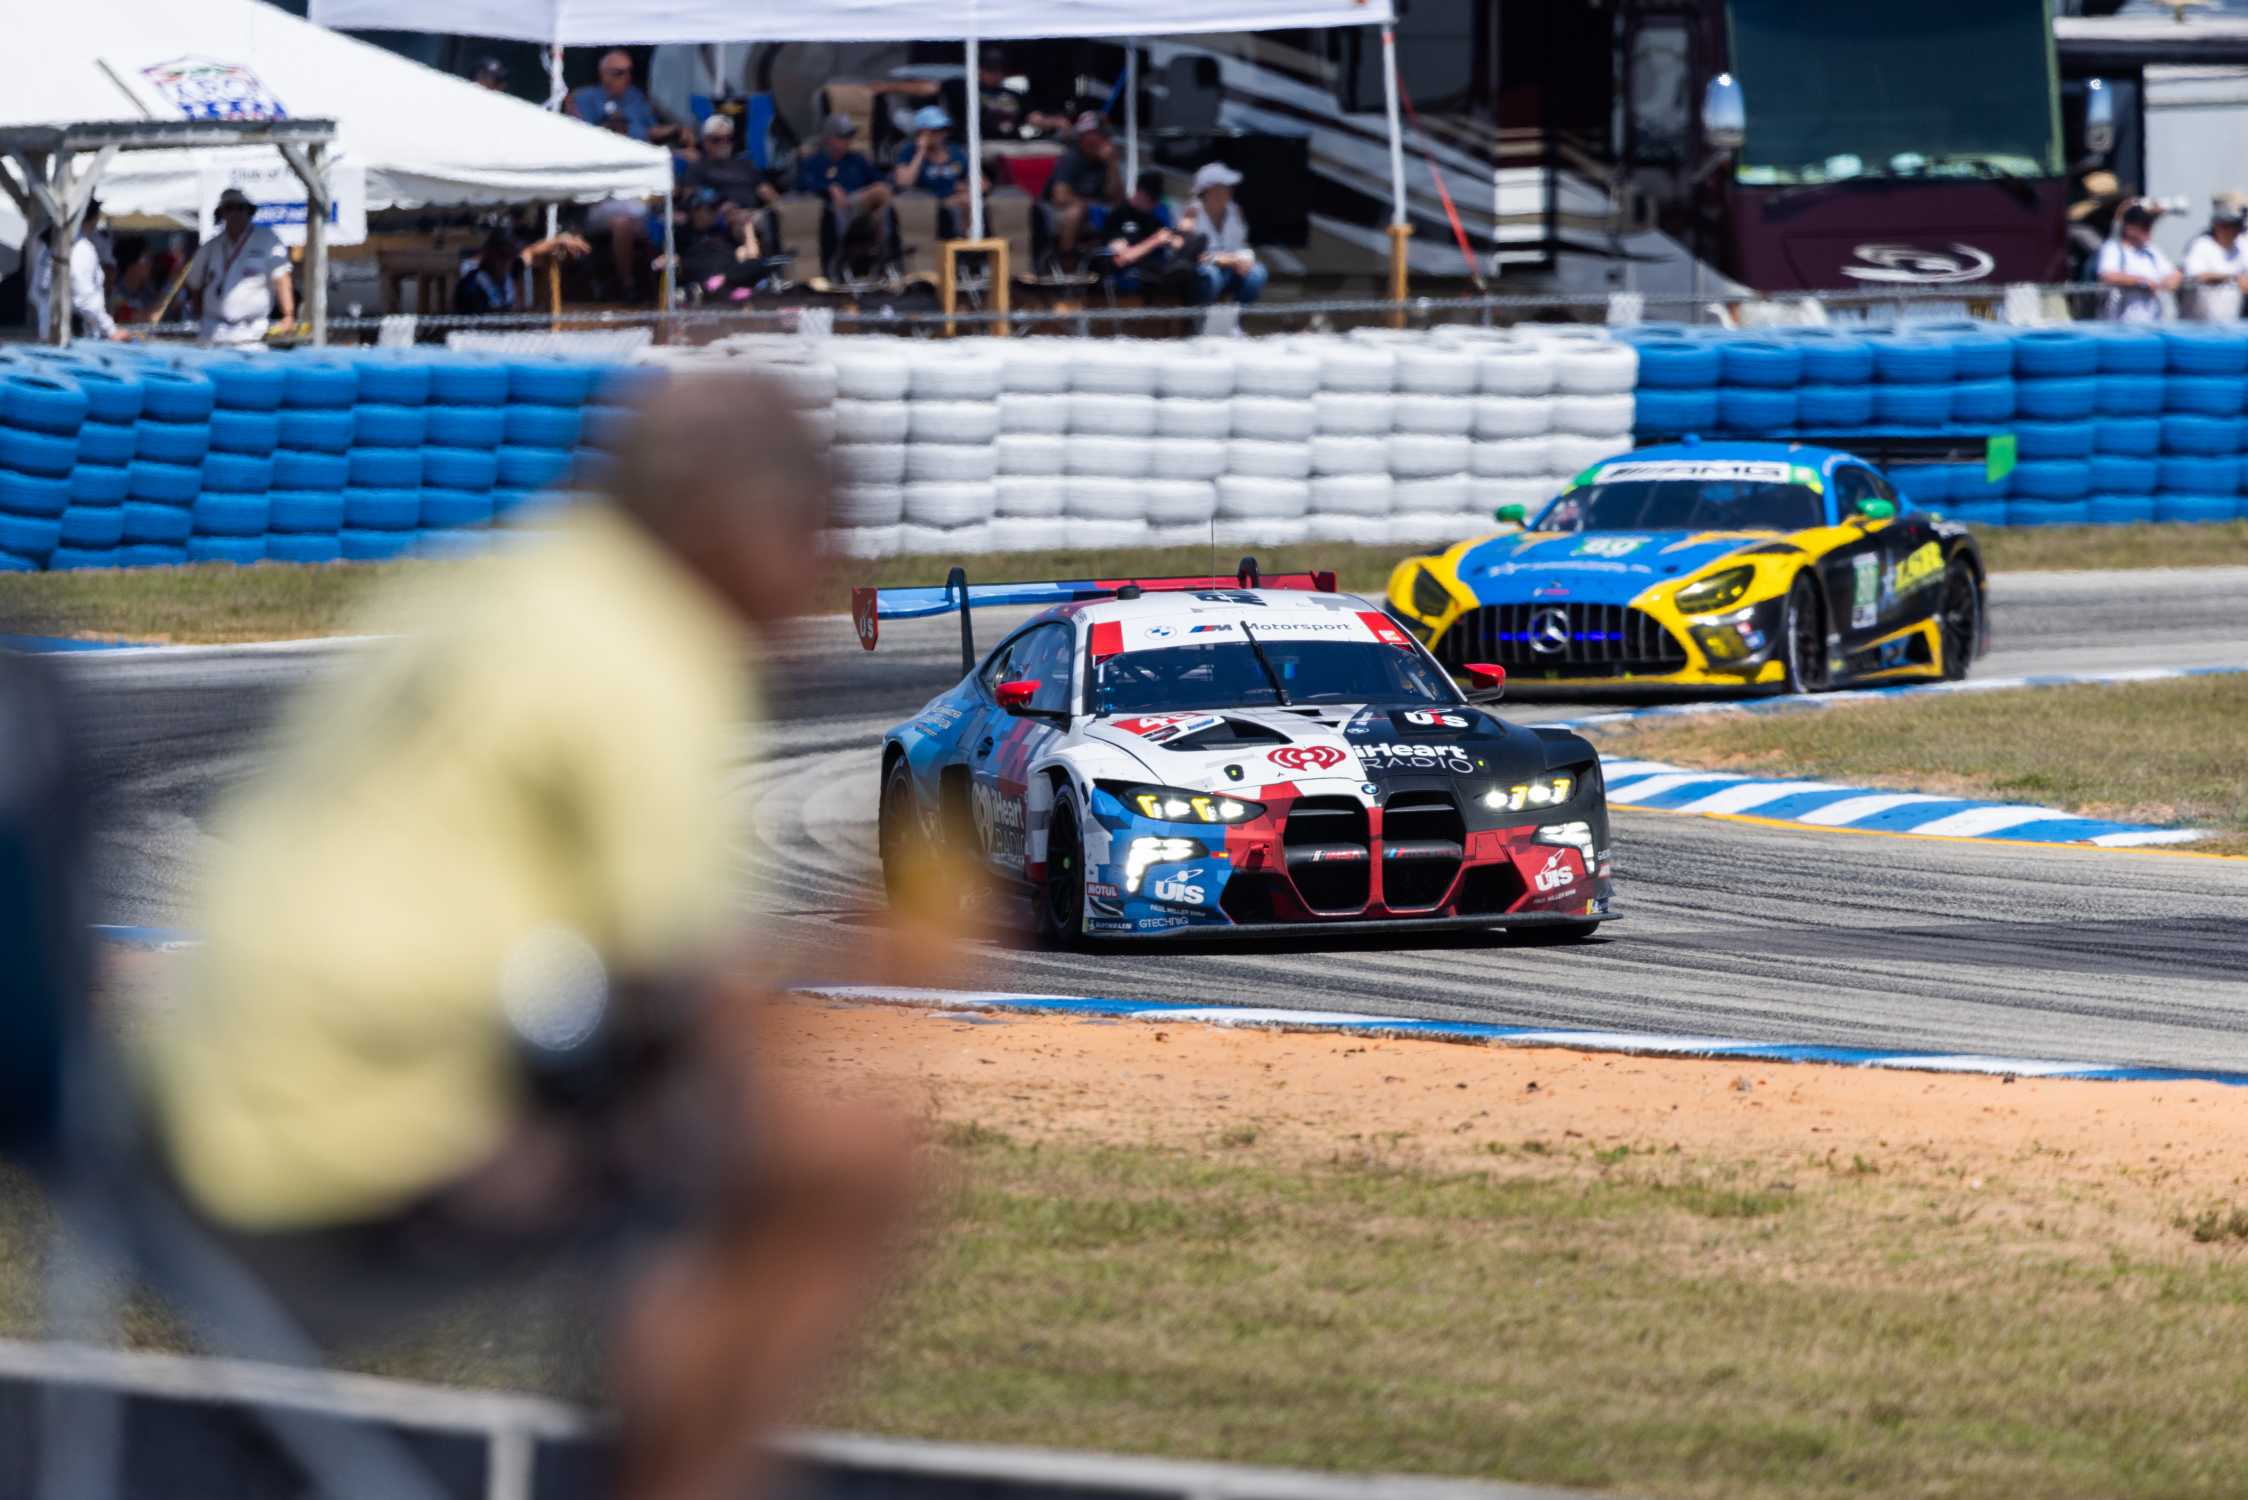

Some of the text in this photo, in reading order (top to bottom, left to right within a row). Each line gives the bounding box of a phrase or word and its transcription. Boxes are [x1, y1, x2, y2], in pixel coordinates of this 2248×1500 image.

[1353, 743, 1468, 759] iHeart
[1360, 757, 1474, 773] RADIO
[1088, 884, 1117, 896] MOTUL
